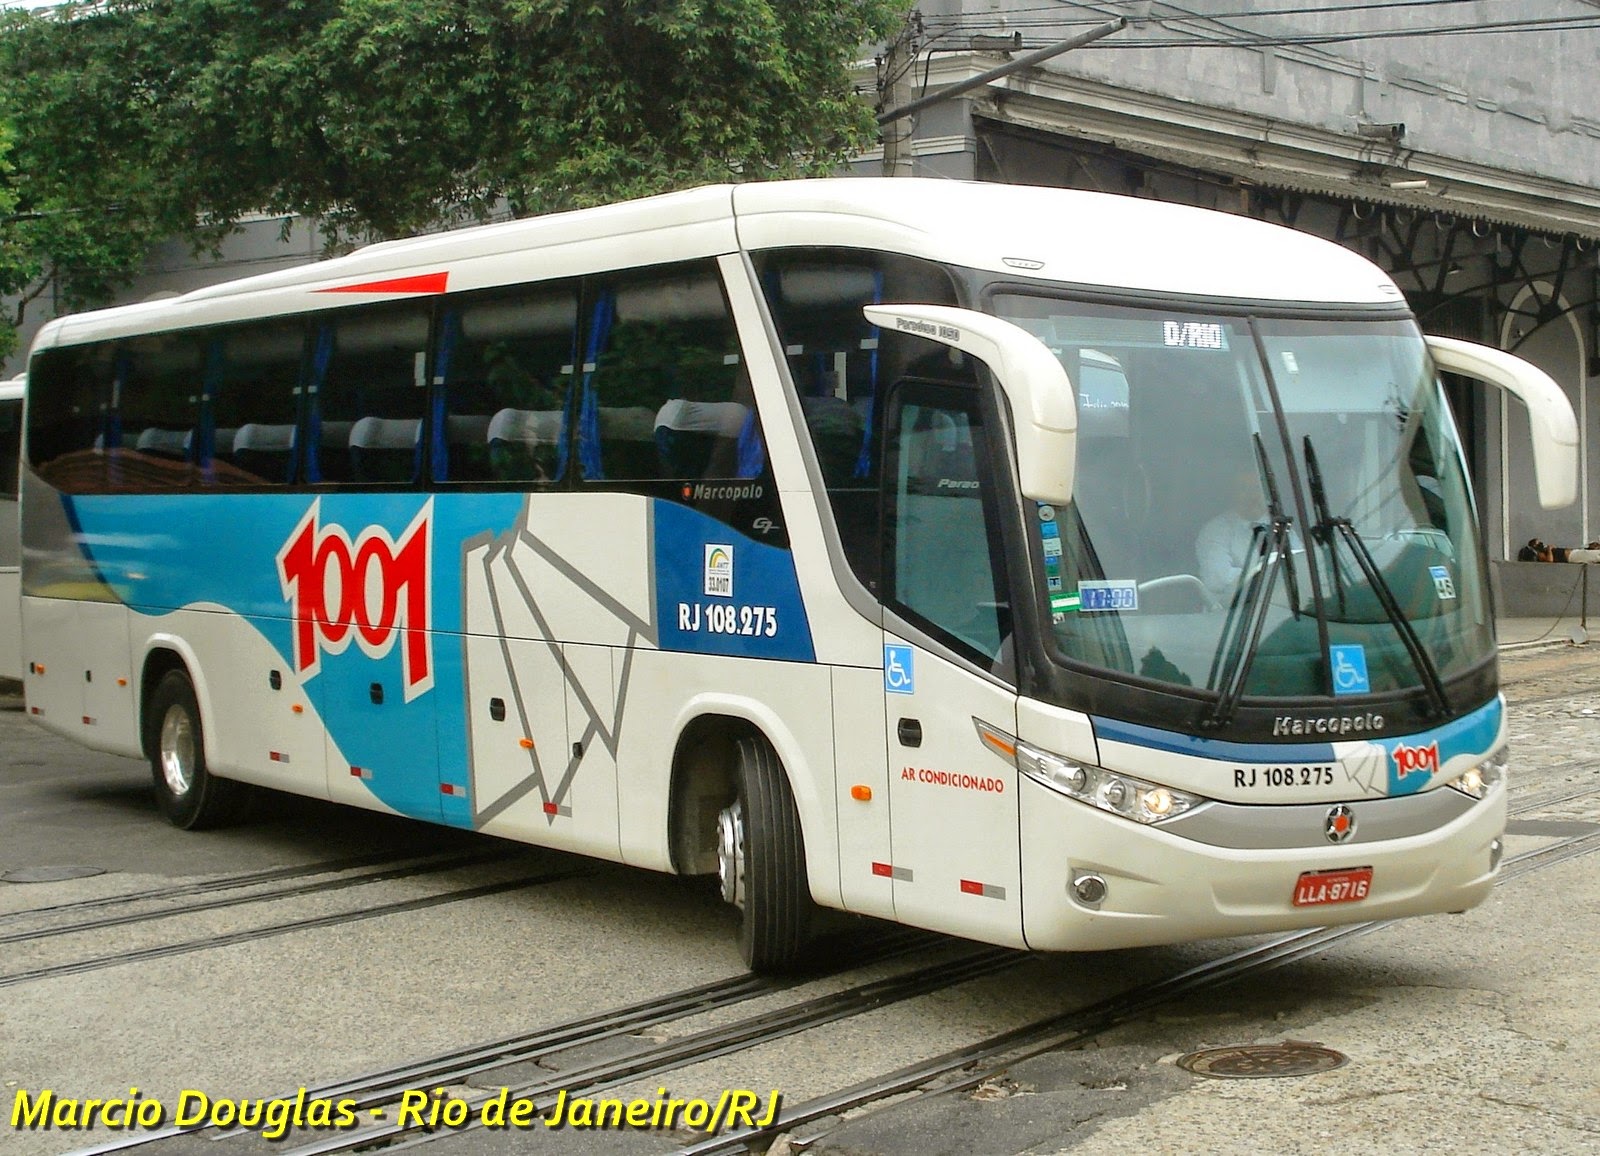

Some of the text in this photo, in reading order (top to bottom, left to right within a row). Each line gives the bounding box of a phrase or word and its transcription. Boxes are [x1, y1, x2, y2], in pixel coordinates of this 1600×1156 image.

[938, 325, 961, 342] 1050
[693, 483, 763, 501] Marcopolo
[278, 500, 434, 700] 1001
[678, 603, 778, 638] RJ 108.275
[1272, 712, 1385, 737] Marcopolo
[1392, 741, 1440, 780] 1001
[901, 767, 1004, 793] AR CONDICIONADO
[1234, 767, 1333, 788] RJ 108.275
